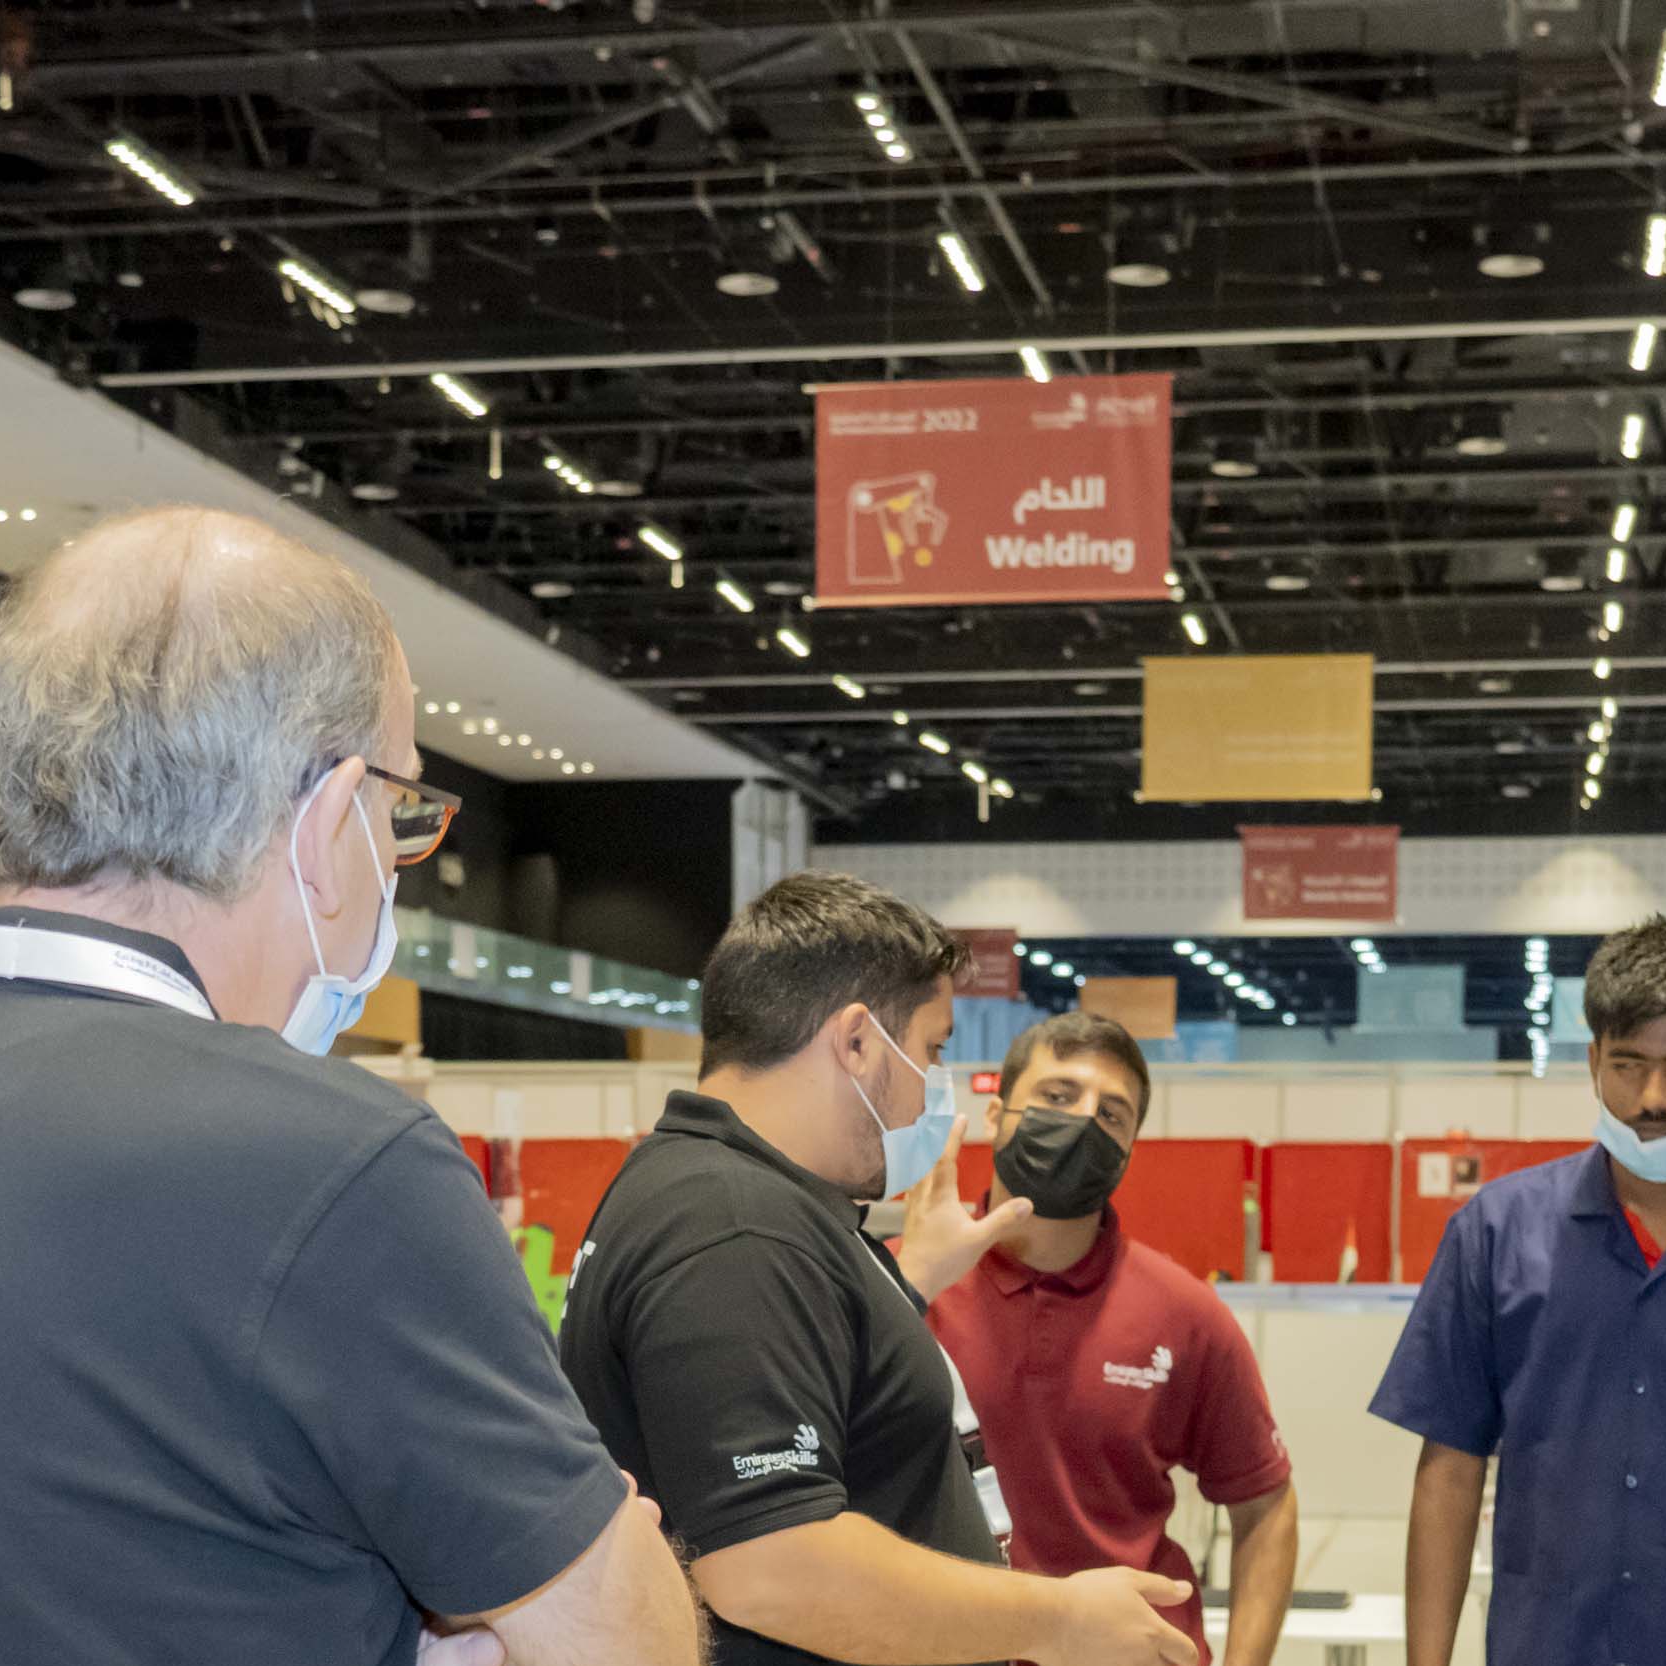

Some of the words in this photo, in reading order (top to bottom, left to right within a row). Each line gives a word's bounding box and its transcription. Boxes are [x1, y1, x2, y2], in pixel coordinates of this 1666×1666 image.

[922, 408, 979, 433] 2022
[1013, 475, 1106, 525] اللحام
[986, 532, 1135, 574] Welding
